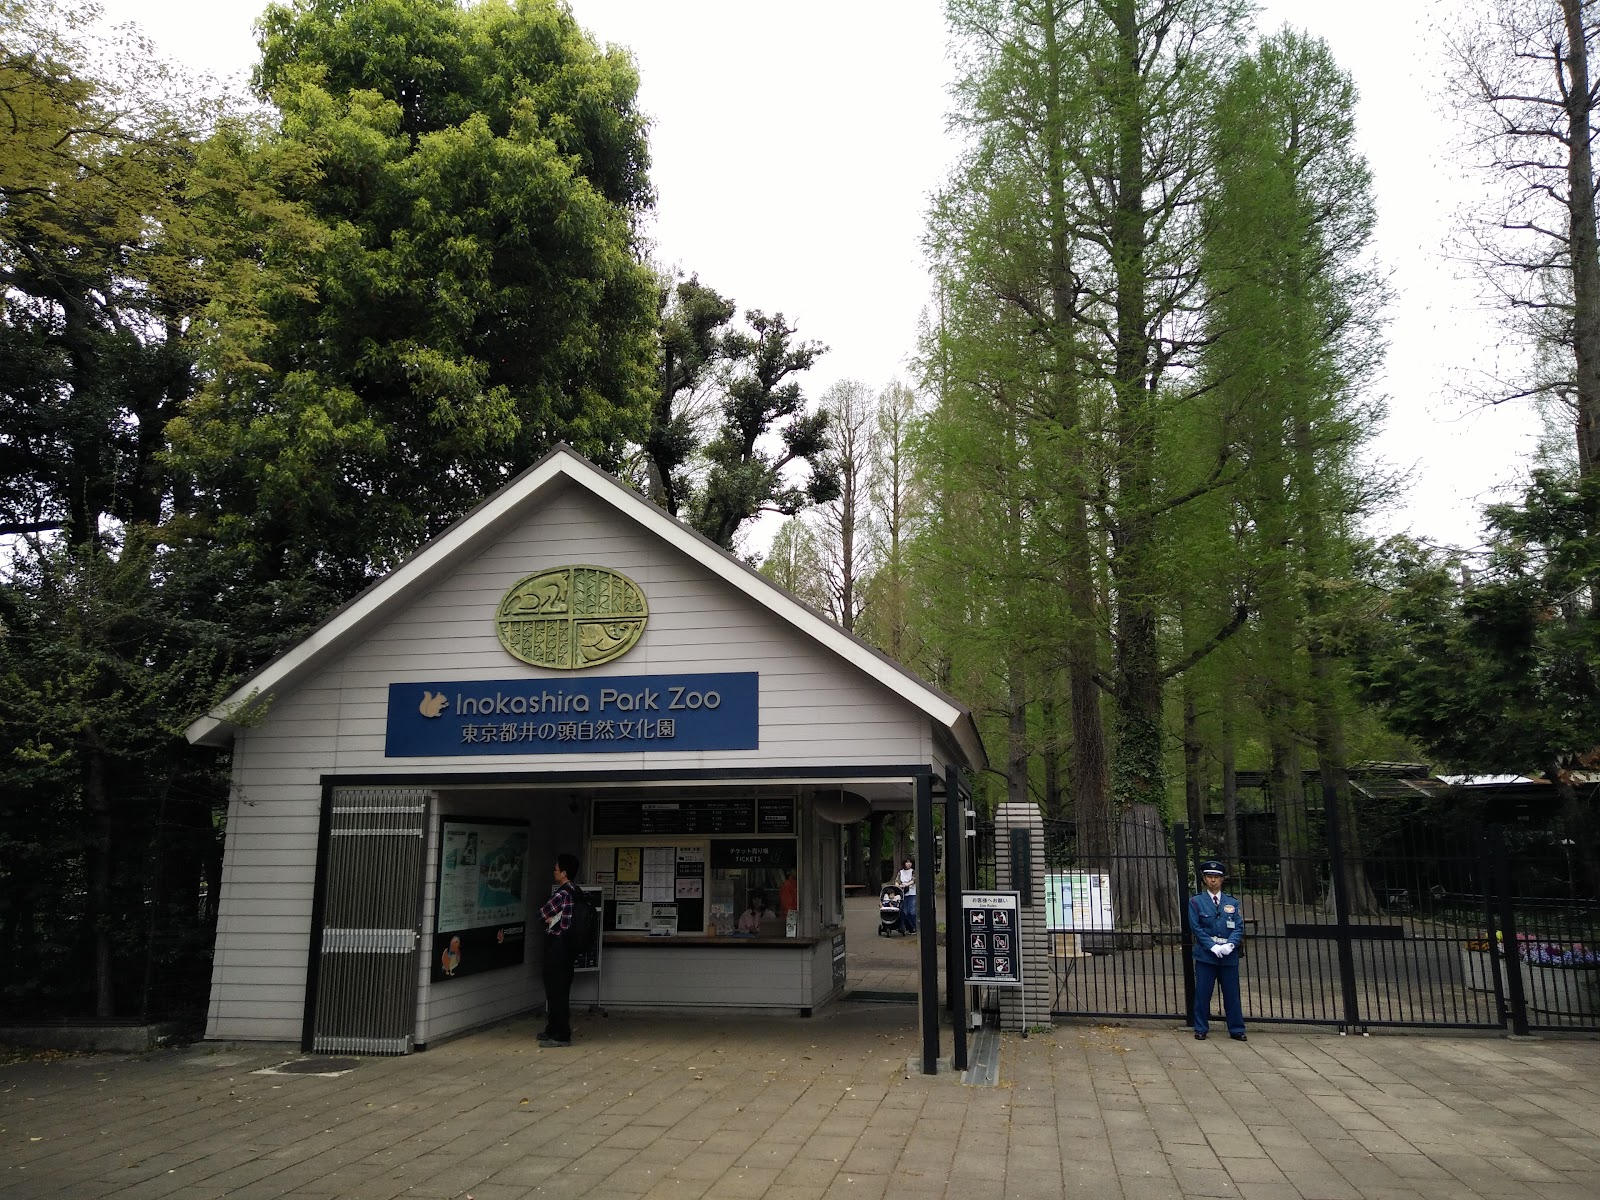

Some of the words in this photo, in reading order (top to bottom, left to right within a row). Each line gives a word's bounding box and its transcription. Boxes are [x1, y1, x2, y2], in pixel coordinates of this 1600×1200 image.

[456, 690, 590, 716] Inokashira
[599, 688, 660, 712] Park
[668, 686, 722, 710] Zoo
[460, 719, 676, 743] 東京都井の頭自然文化園
[729, 847, 769, 855] チケット売り場
